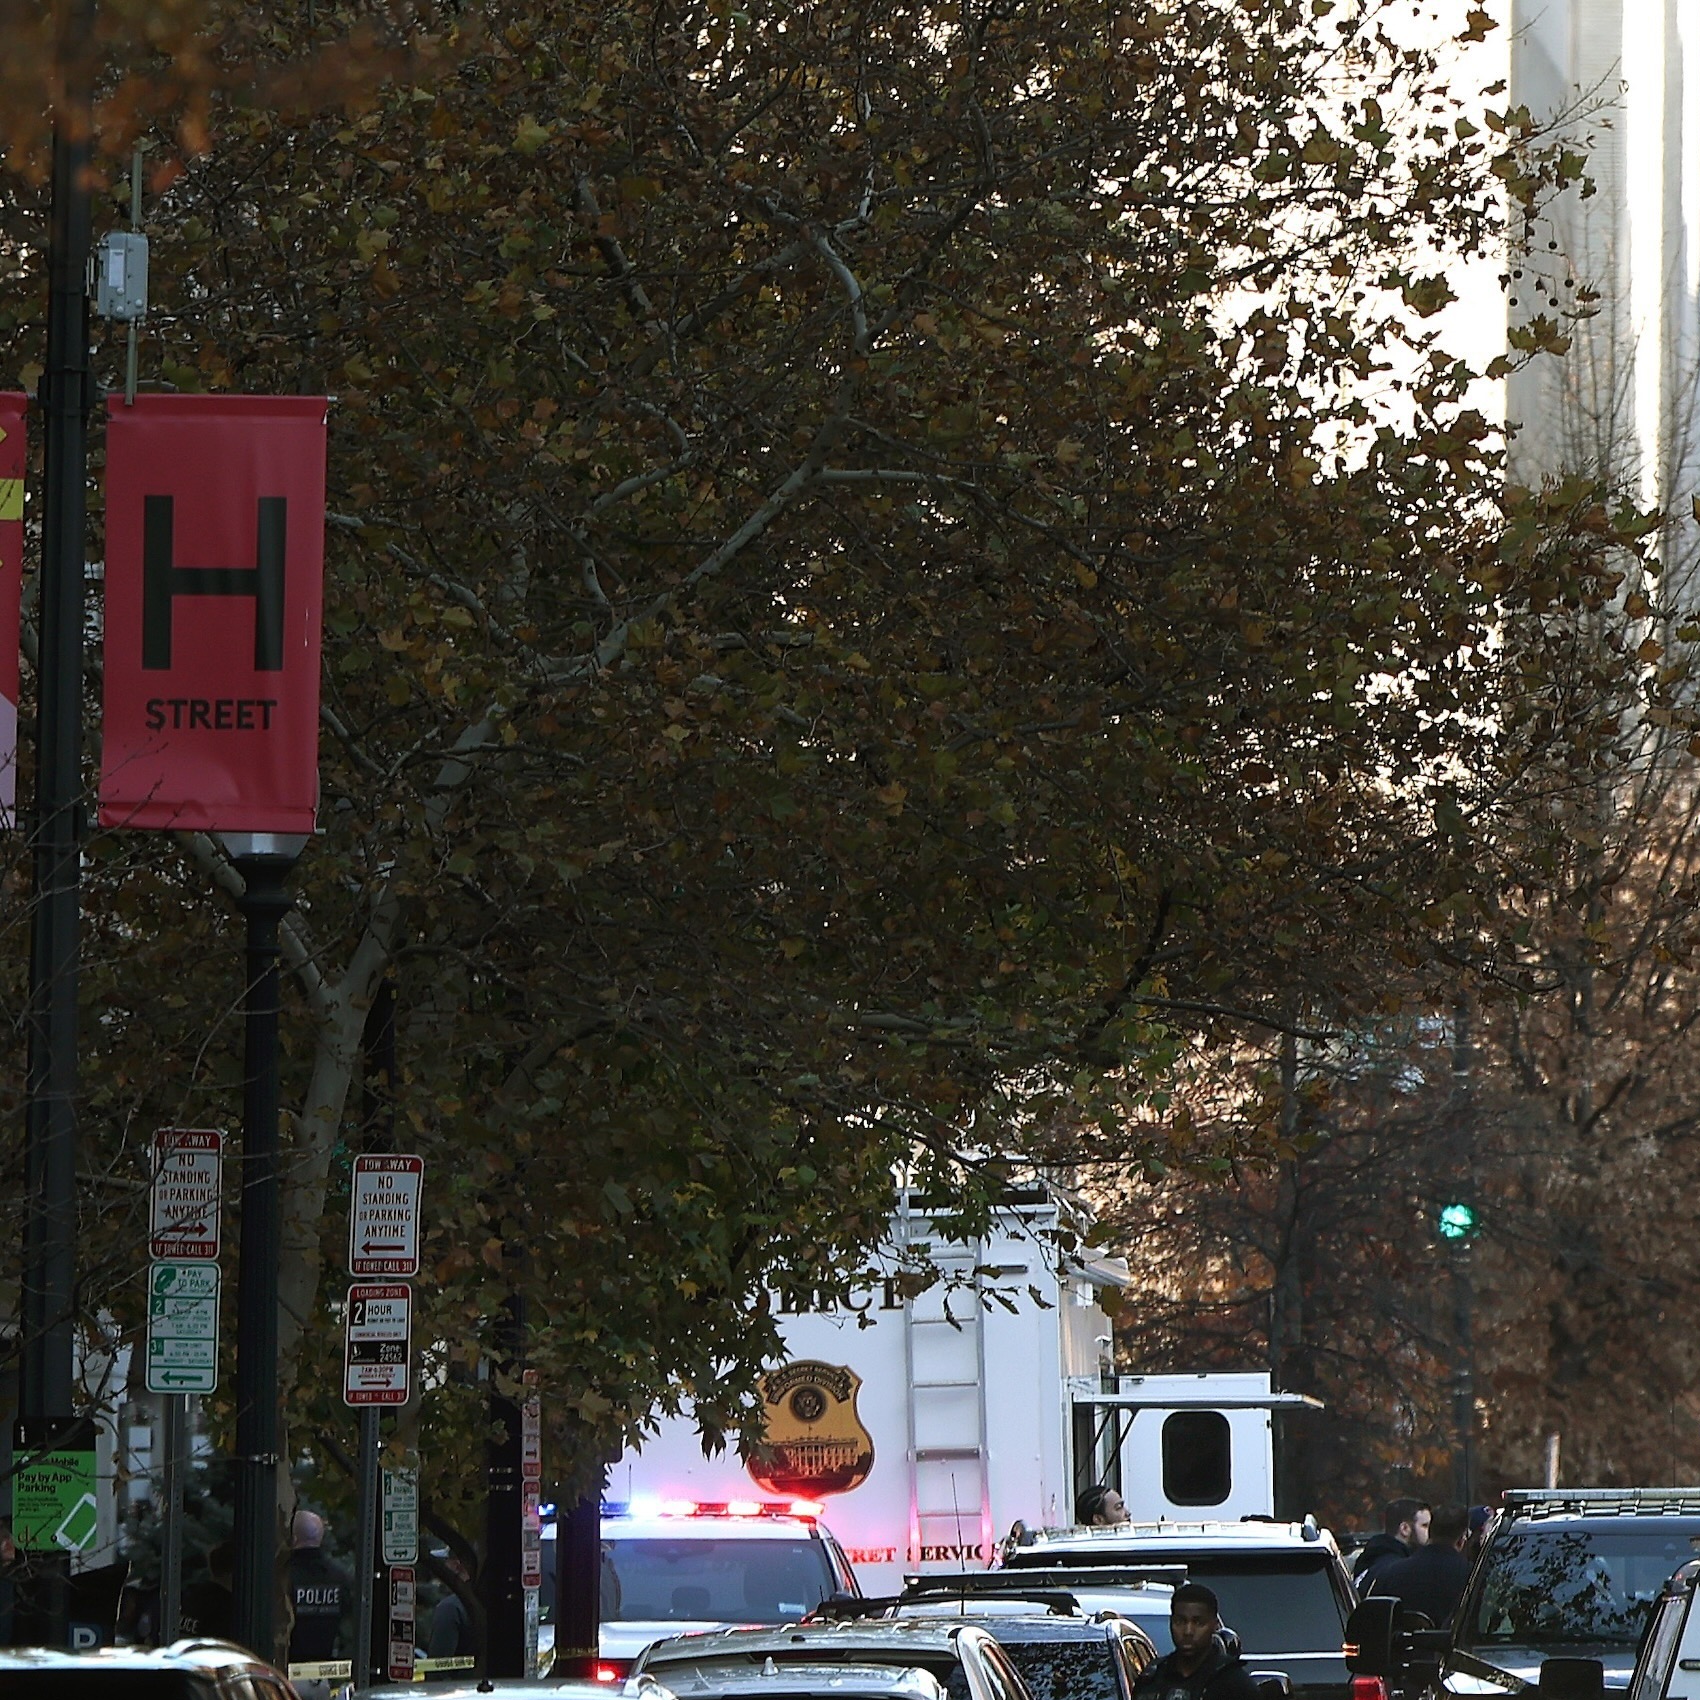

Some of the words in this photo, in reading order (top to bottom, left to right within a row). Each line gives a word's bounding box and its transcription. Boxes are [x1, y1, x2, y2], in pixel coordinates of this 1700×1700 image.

[143, 495, 287, 671] H
[145, 700, 277, 731] STREET
[178, 1153, 195, 1166] NO
[162, 1170, 211, 1184] STANDING
[378, 1176, 393, 1189] NO
[170, 1188, 212, 1201] PARKING
[362, 1193, 409, 1205] STANDING
[369, 1209, 411, 1221] PARKING
[365, 1225, 406, 1238] ANYTIME
[353, 1301, 363, 1324] 2
[368, 1305, 392, 1316] HOUR
[18, 1473, 36, 1484] Pay
[38, 1472, 50, 1484] by
[52, 1473, 72, 1484] App
[18, 1483, 56, 1494] Parking
[297, 1588, 340, 1604] POLICE
